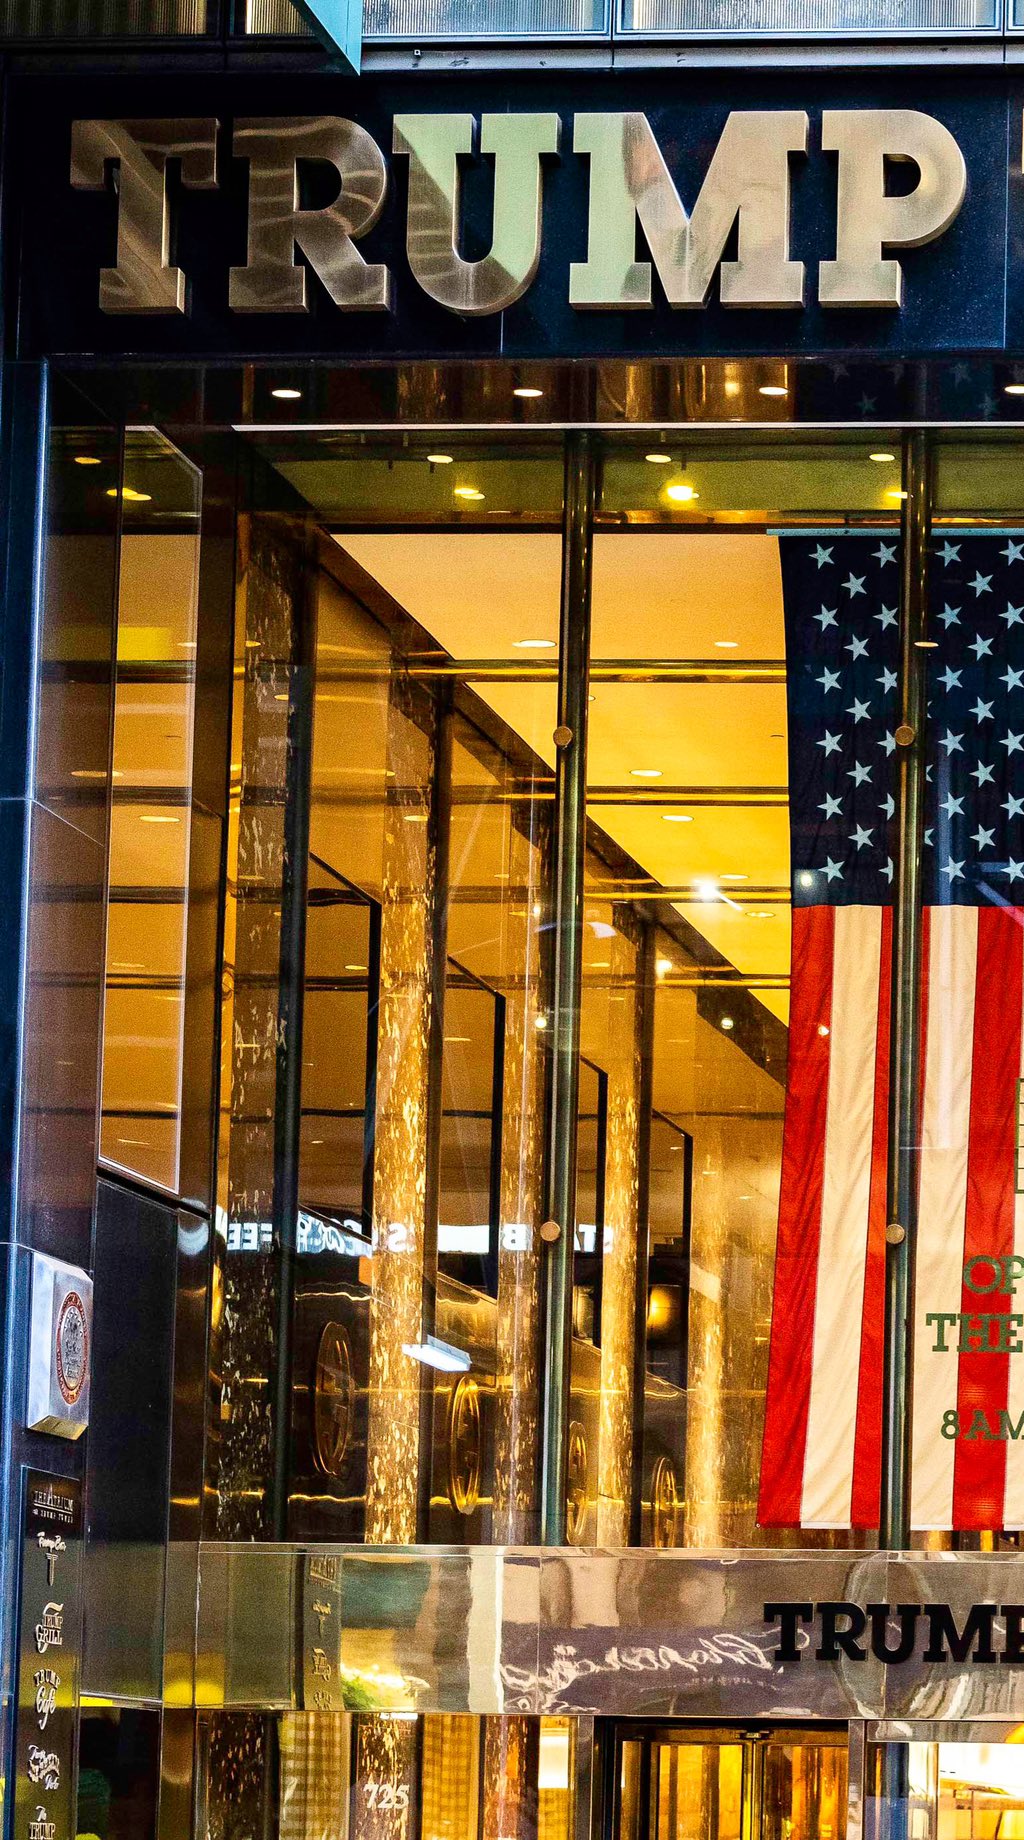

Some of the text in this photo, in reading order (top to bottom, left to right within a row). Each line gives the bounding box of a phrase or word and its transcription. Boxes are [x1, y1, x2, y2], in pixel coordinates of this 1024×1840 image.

[70, 109, 967, 316] TRUMP
[925, 1313, 1024, 1353] THE
[363, 1783, 410, 1809] 725
